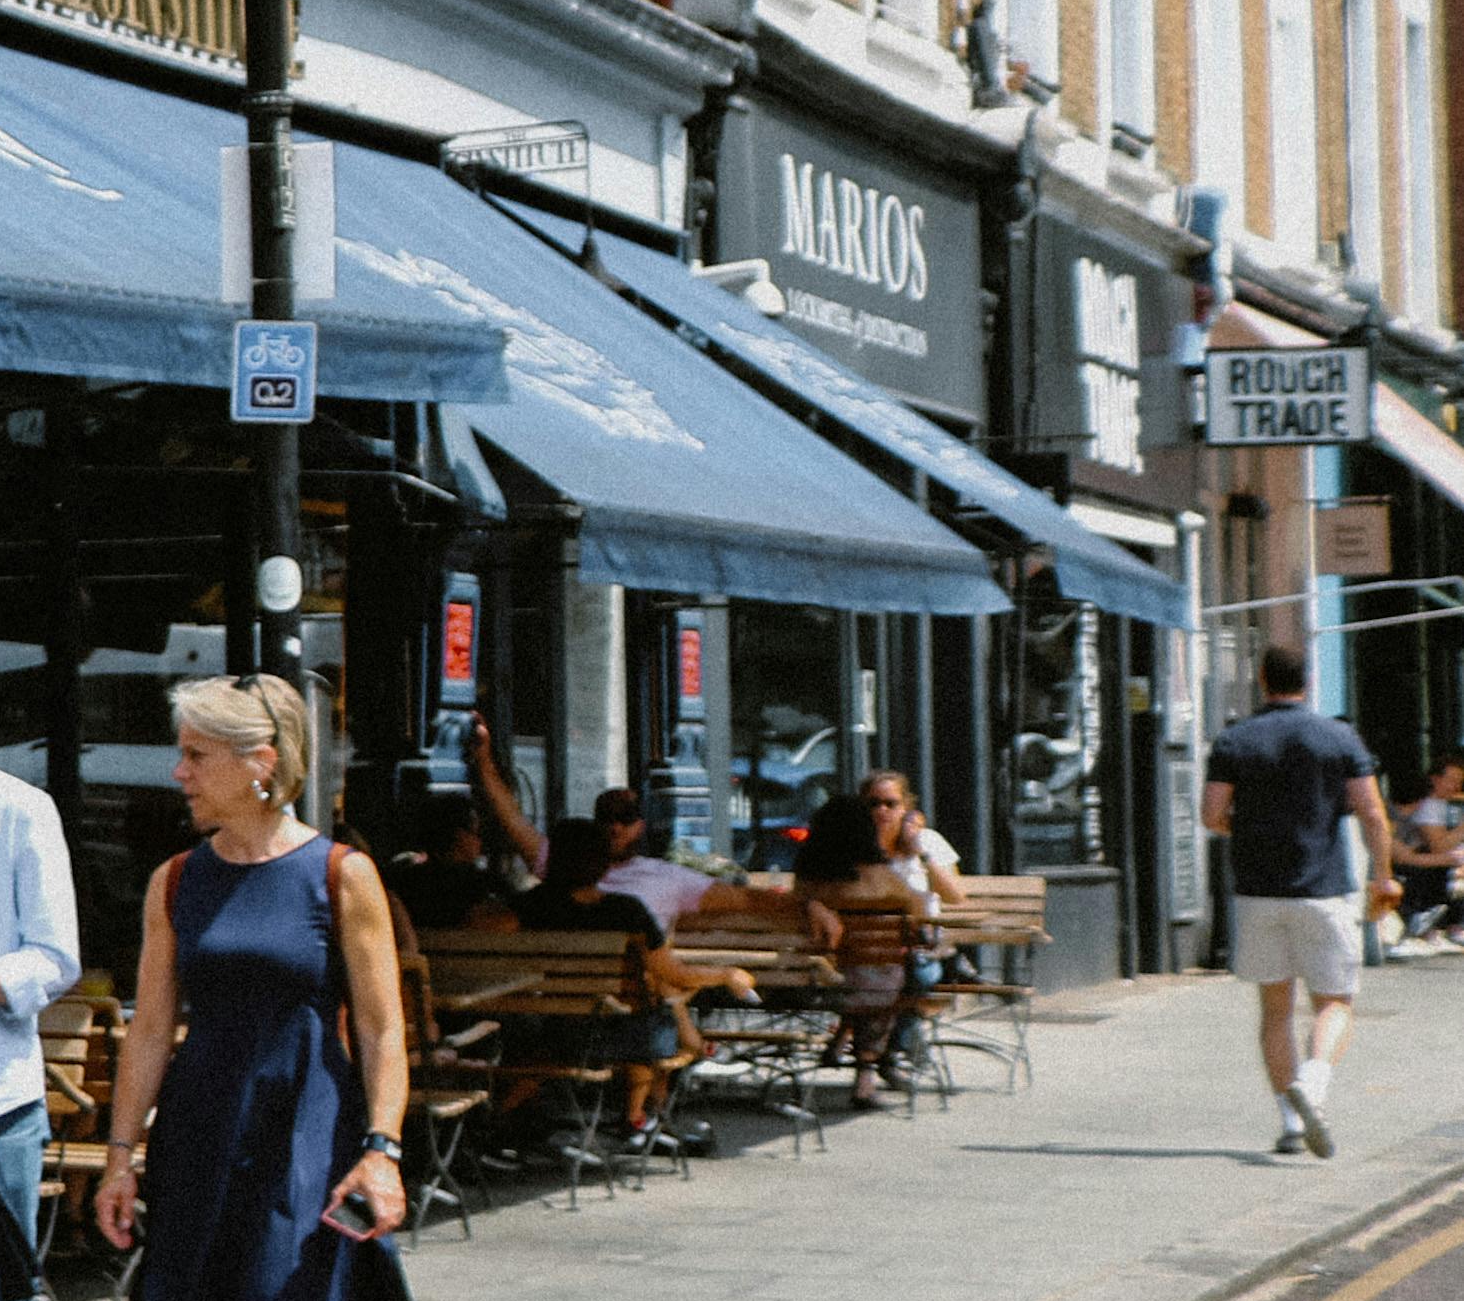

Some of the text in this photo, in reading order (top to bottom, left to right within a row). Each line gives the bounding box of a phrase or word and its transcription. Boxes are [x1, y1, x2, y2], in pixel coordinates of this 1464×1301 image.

[780, 153, 928, 301] MARIOS
[254, 382, 294, 404] Q2
[1229, 356, 1348, 394] ROUGH
[1232, 399, 1350, 437] TRADE
